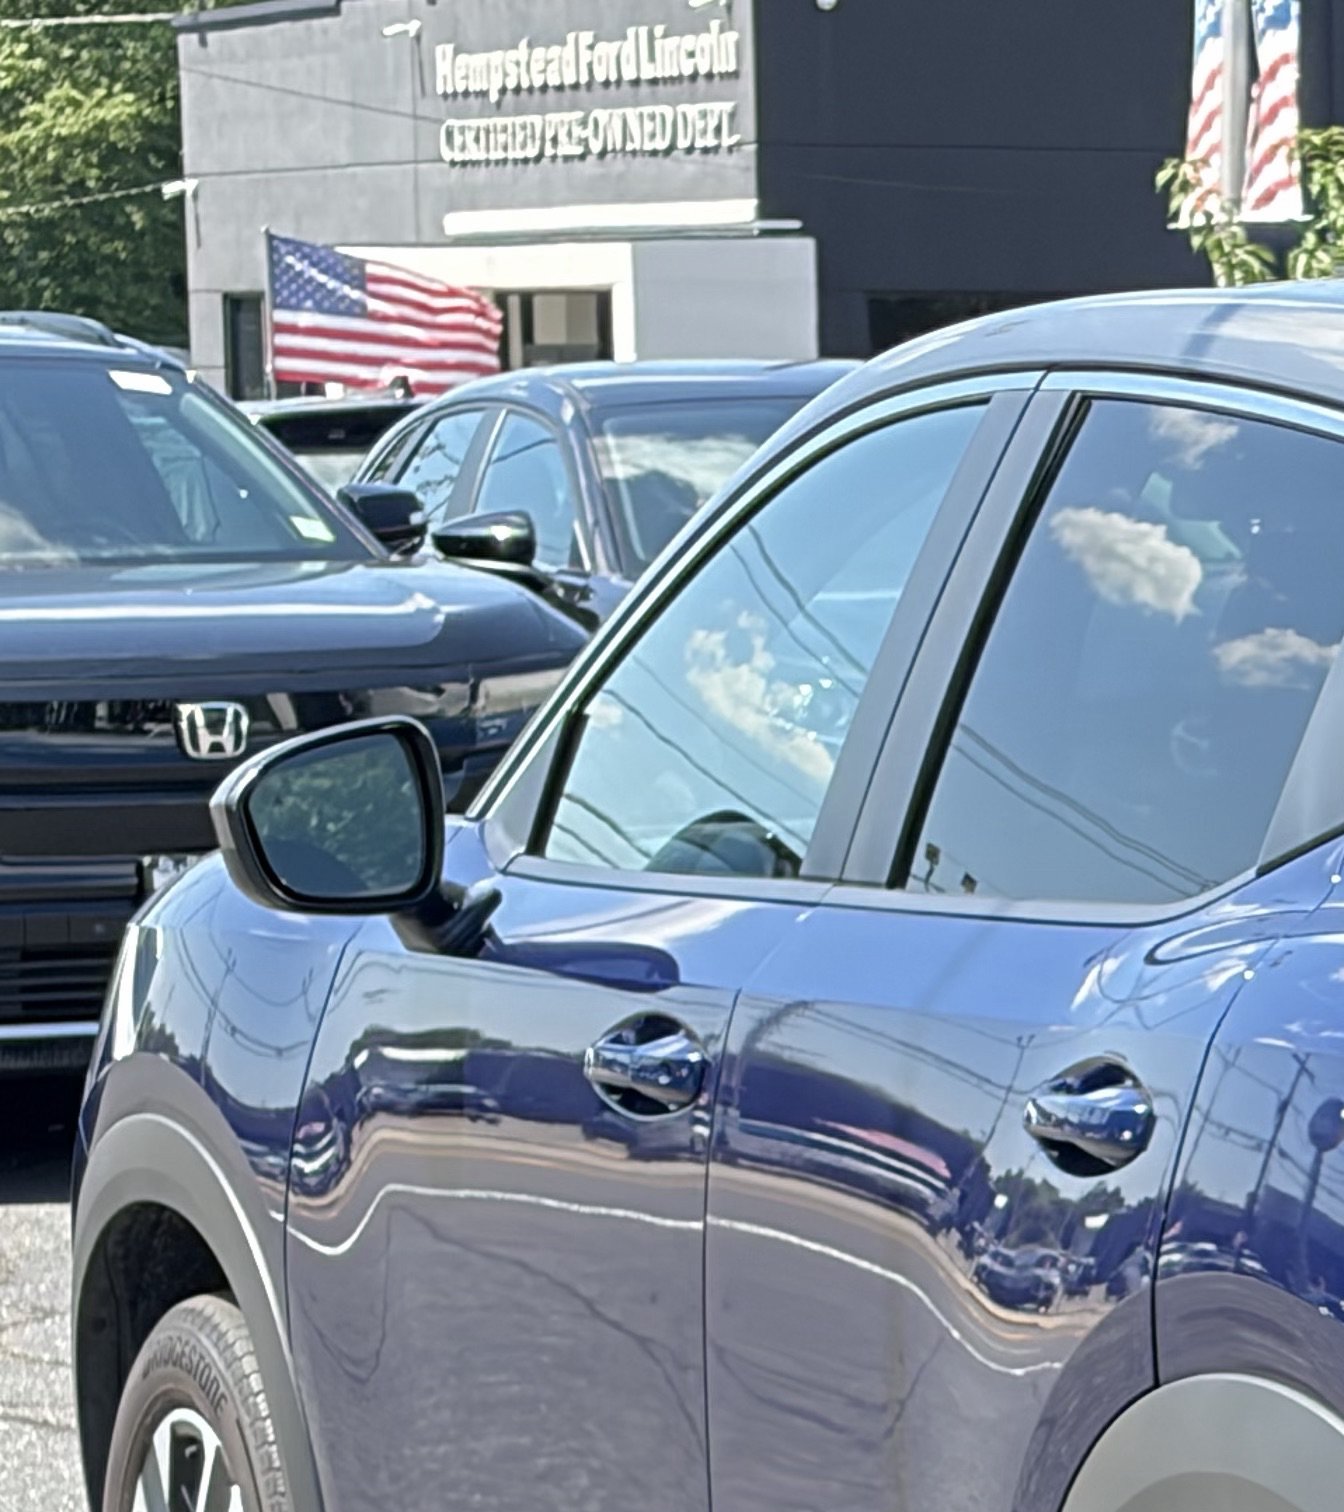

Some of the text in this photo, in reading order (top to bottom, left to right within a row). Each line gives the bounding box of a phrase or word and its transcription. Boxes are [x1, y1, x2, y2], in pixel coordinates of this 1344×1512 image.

[435, 19, 739, 103] Hempstead Ford Lincoln
